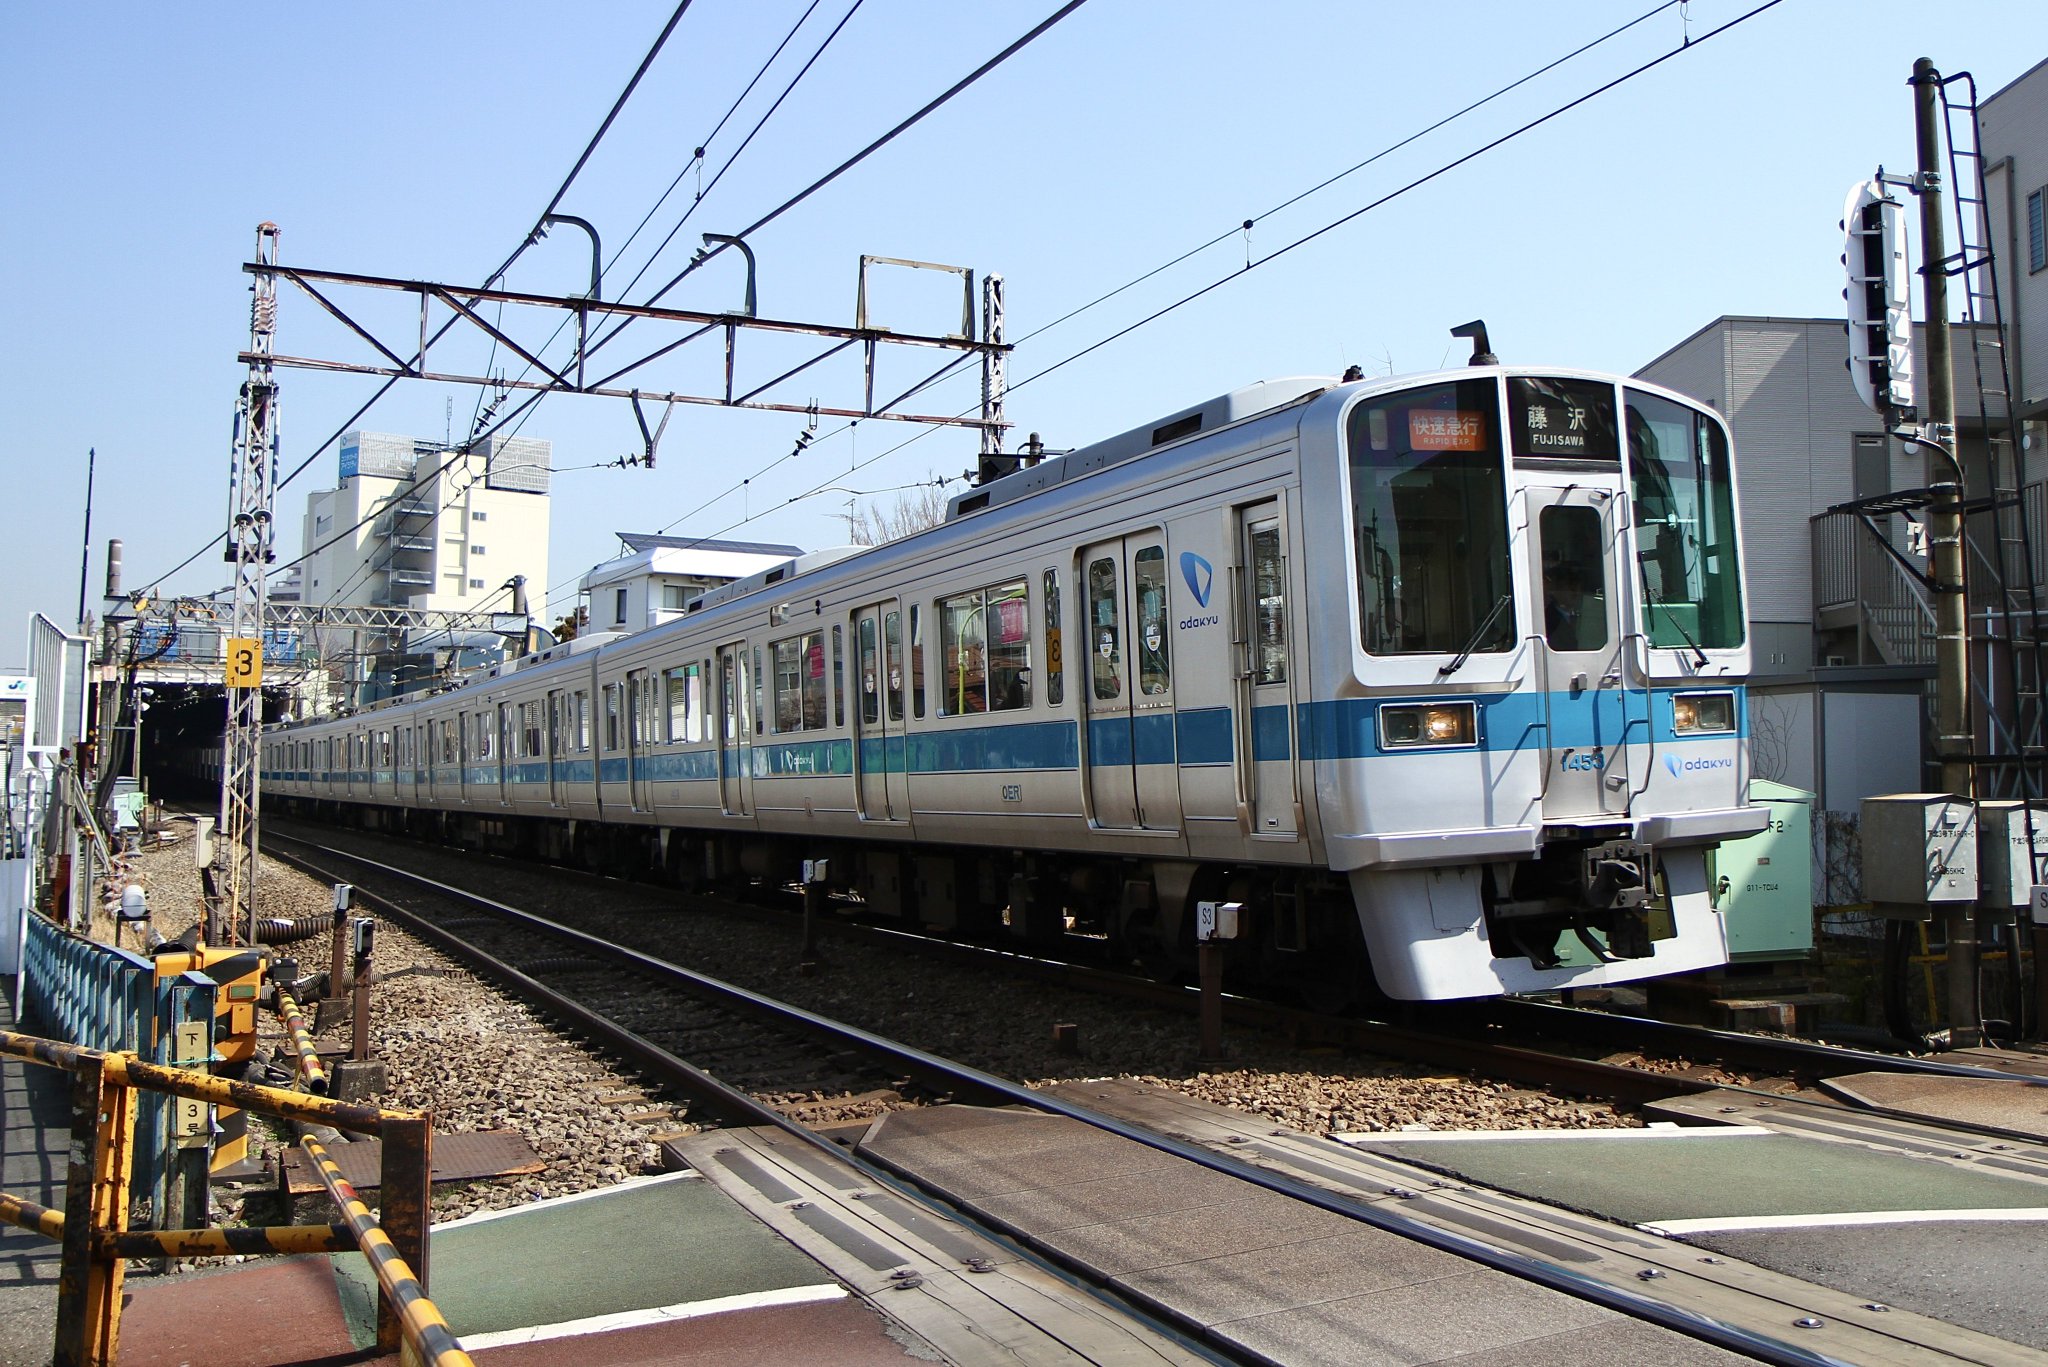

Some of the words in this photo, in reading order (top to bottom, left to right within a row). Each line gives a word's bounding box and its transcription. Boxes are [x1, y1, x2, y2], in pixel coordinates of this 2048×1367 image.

[1527, 404, 1588, 431] 藤沢
[1412, 415, 1479, 436] 快速急行
[1423, 437, 1450, 445] RAPID
[1452, 437, 1472, 446] EXP.
[1532, 434, 1584, 446] FUJISAWA
[1179, 615, 1219, 630] odakyu
[253, 640, 260, 650] 2
[234, 649, 253, 676] 3
[230, 676, 235, 685] 1
[1684, 757, 1732, 770] odakyu
[1002, 785, 1020, 800] OER
[1201, 907, 1212, 925] S3
